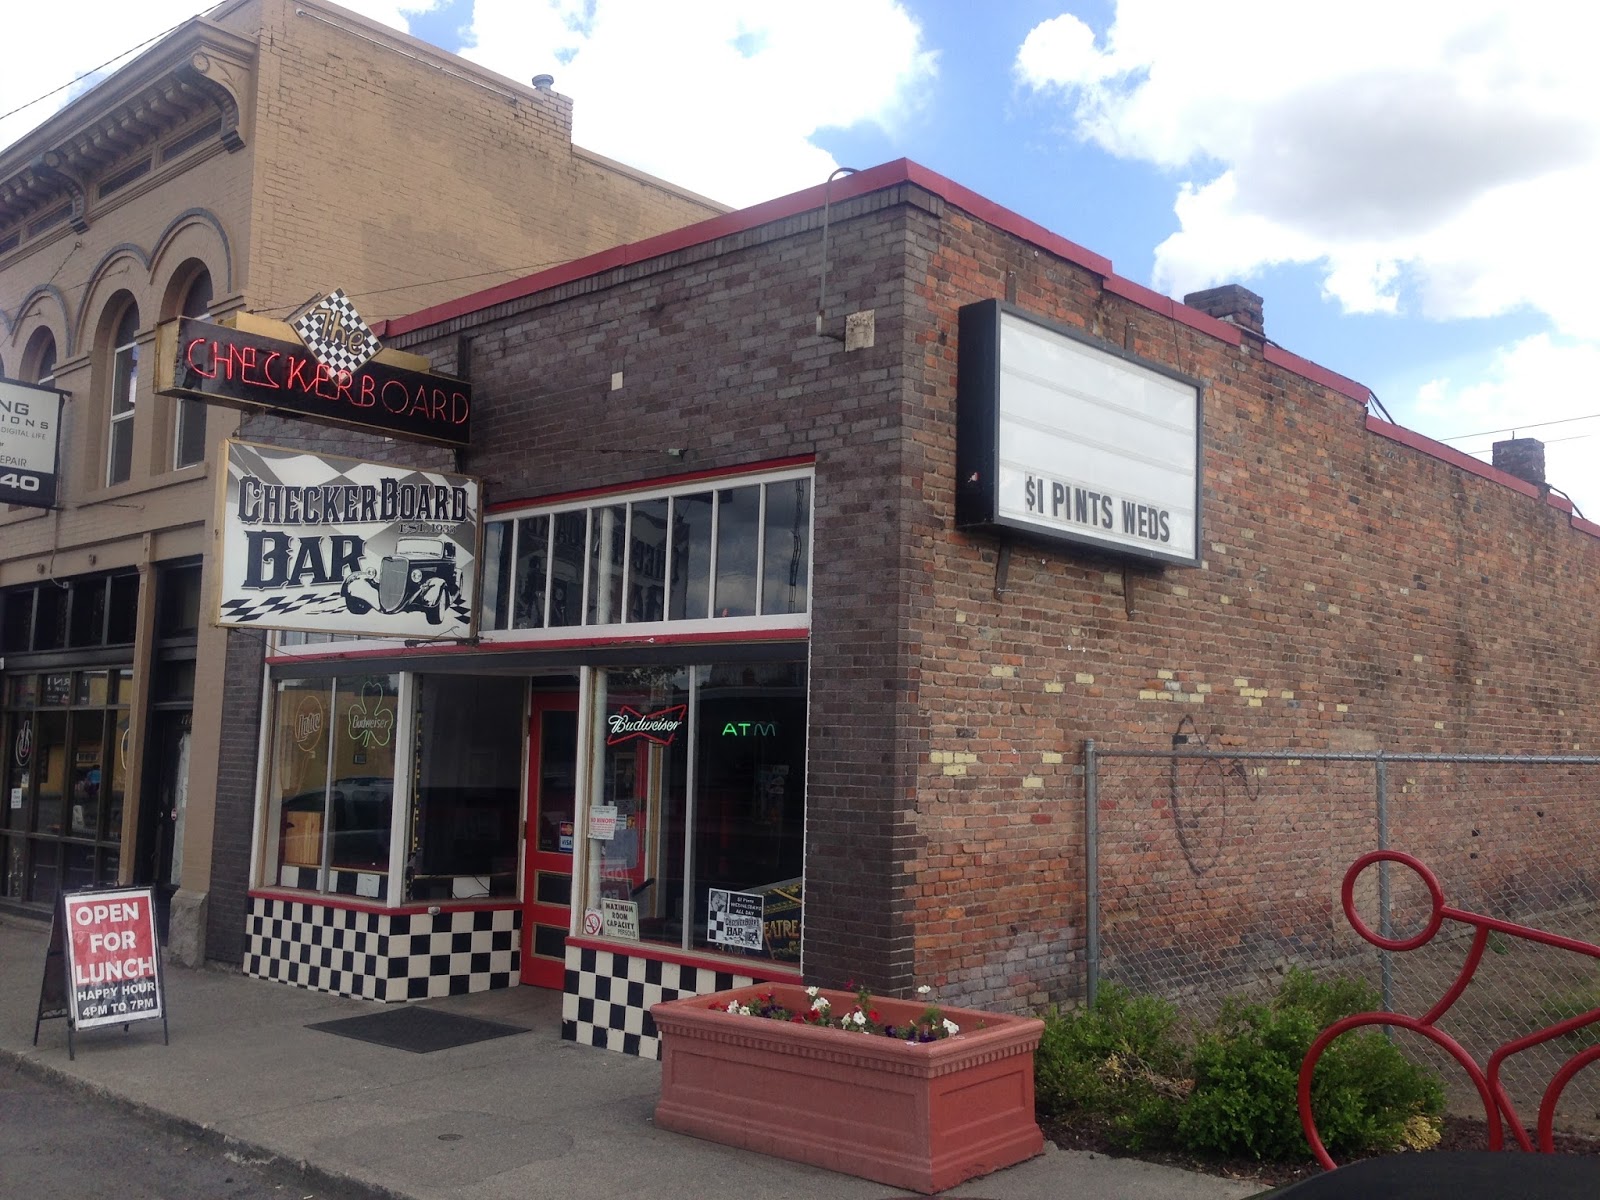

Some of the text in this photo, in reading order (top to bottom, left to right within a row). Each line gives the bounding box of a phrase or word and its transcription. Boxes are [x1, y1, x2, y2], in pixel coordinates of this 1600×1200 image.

[312, 308, 365, 355] The
[1, 426, 46, 440] DIGITAL LIFE
[1052, 481, 1113, 529] PINTS
[1122, 499, 1170, 543] WEDS
[241, 529, 367, 591] BAR
[352, 714, 389, 729] Budweiser
[608, 714, 682, 734] Budweiser
[722, 723, 776, 737] ATM
[75, 902, 140, 926] OPEN
[605, 903, 633, 913] MAXIMUM
[612, 911, 628, 920] ROOM
[606, 920, 634, 930] CAPACITY
[726, 927, 743, 937] BAR
[90, 930, 137, 954] FOR
[76, 957, 154, 985] LUNCH
[78, 982, 155, 1001] HAPPY HOUR
[82, 998, 154, 1017] 4PM TO 7PM
